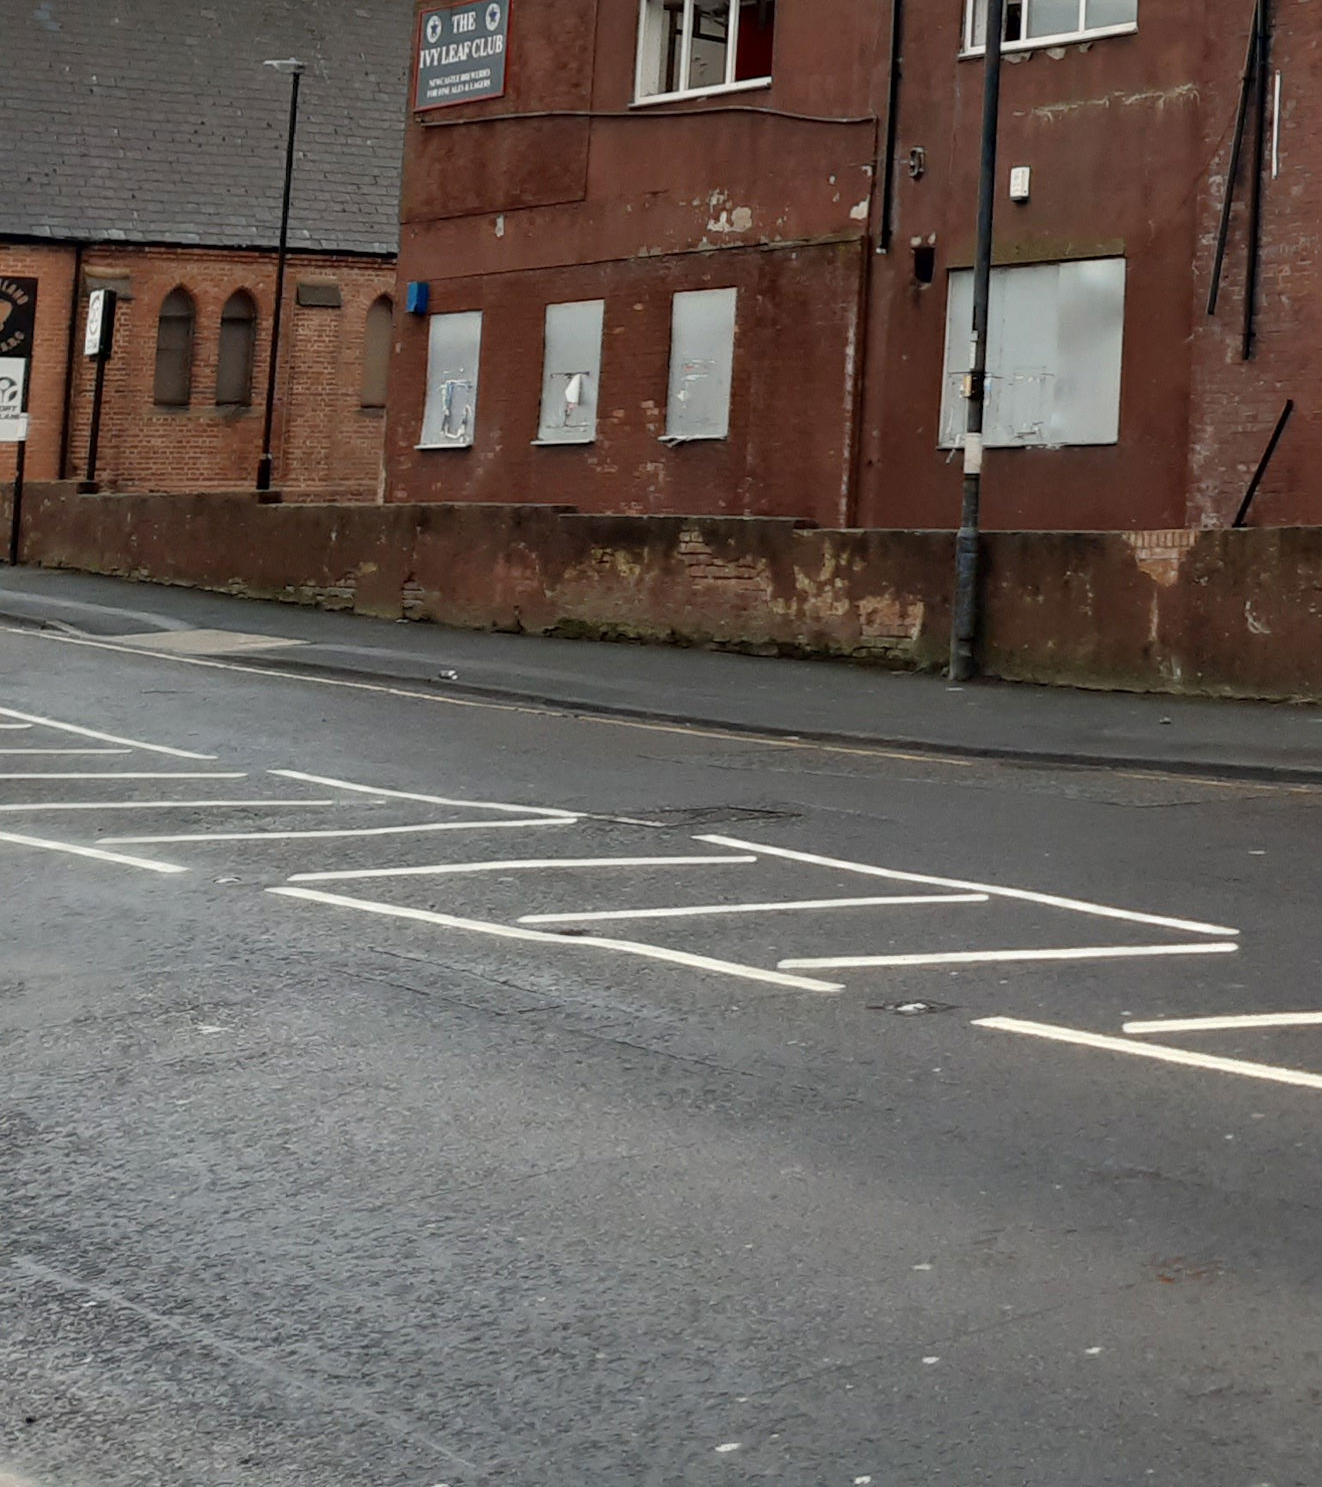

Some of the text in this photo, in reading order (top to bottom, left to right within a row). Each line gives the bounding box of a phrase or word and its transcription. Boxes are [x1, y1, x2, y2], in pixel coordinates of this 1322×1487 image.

[452, 11, 476, 34] THE
[420, 35, 503, 69] IVY LEAF CLUB
